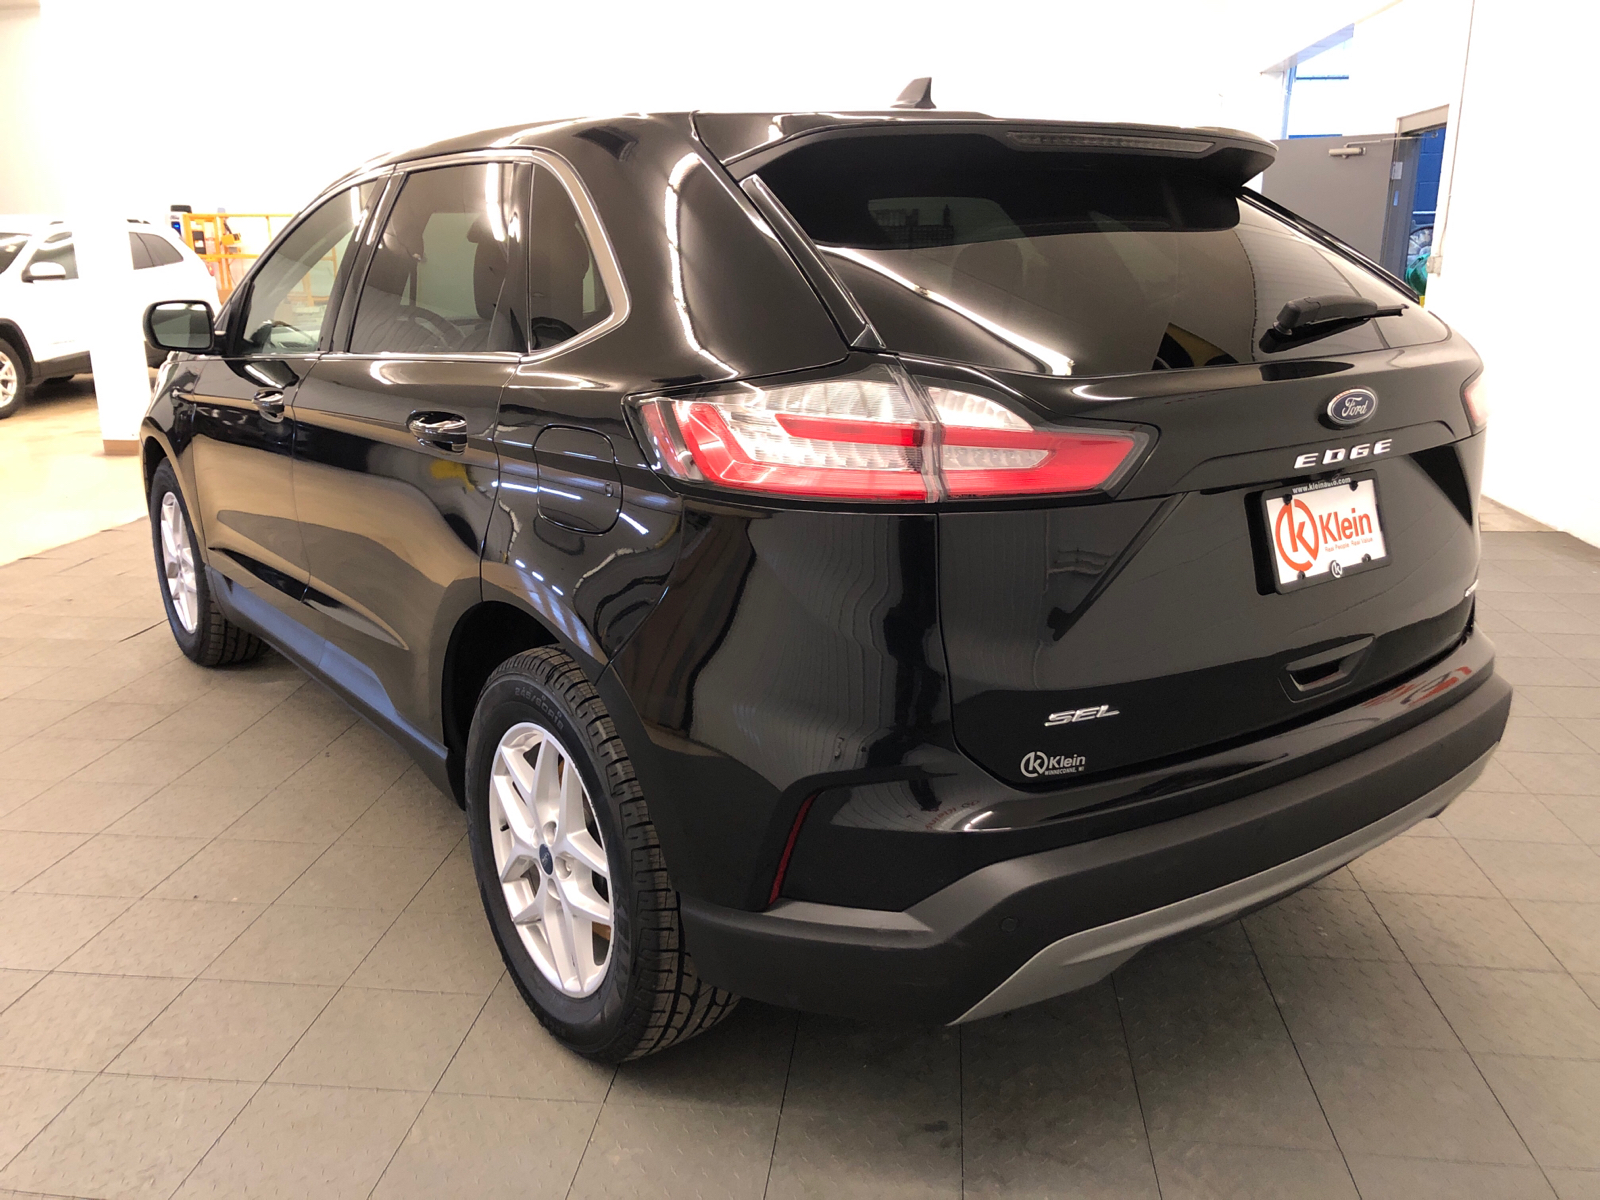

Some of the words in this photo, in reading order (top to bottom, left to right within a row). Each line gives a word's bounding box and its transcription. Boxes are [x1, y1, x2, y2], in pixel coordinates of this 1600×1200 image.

[1341, 397, 1368, 417] Ford
[1293, 439, 1392, 469] EDGE
[1318, 508, 1373, 544] Klein
[1044, 704, 1120, 727] SEL
[1048, 754, 1086, 769] Klein
